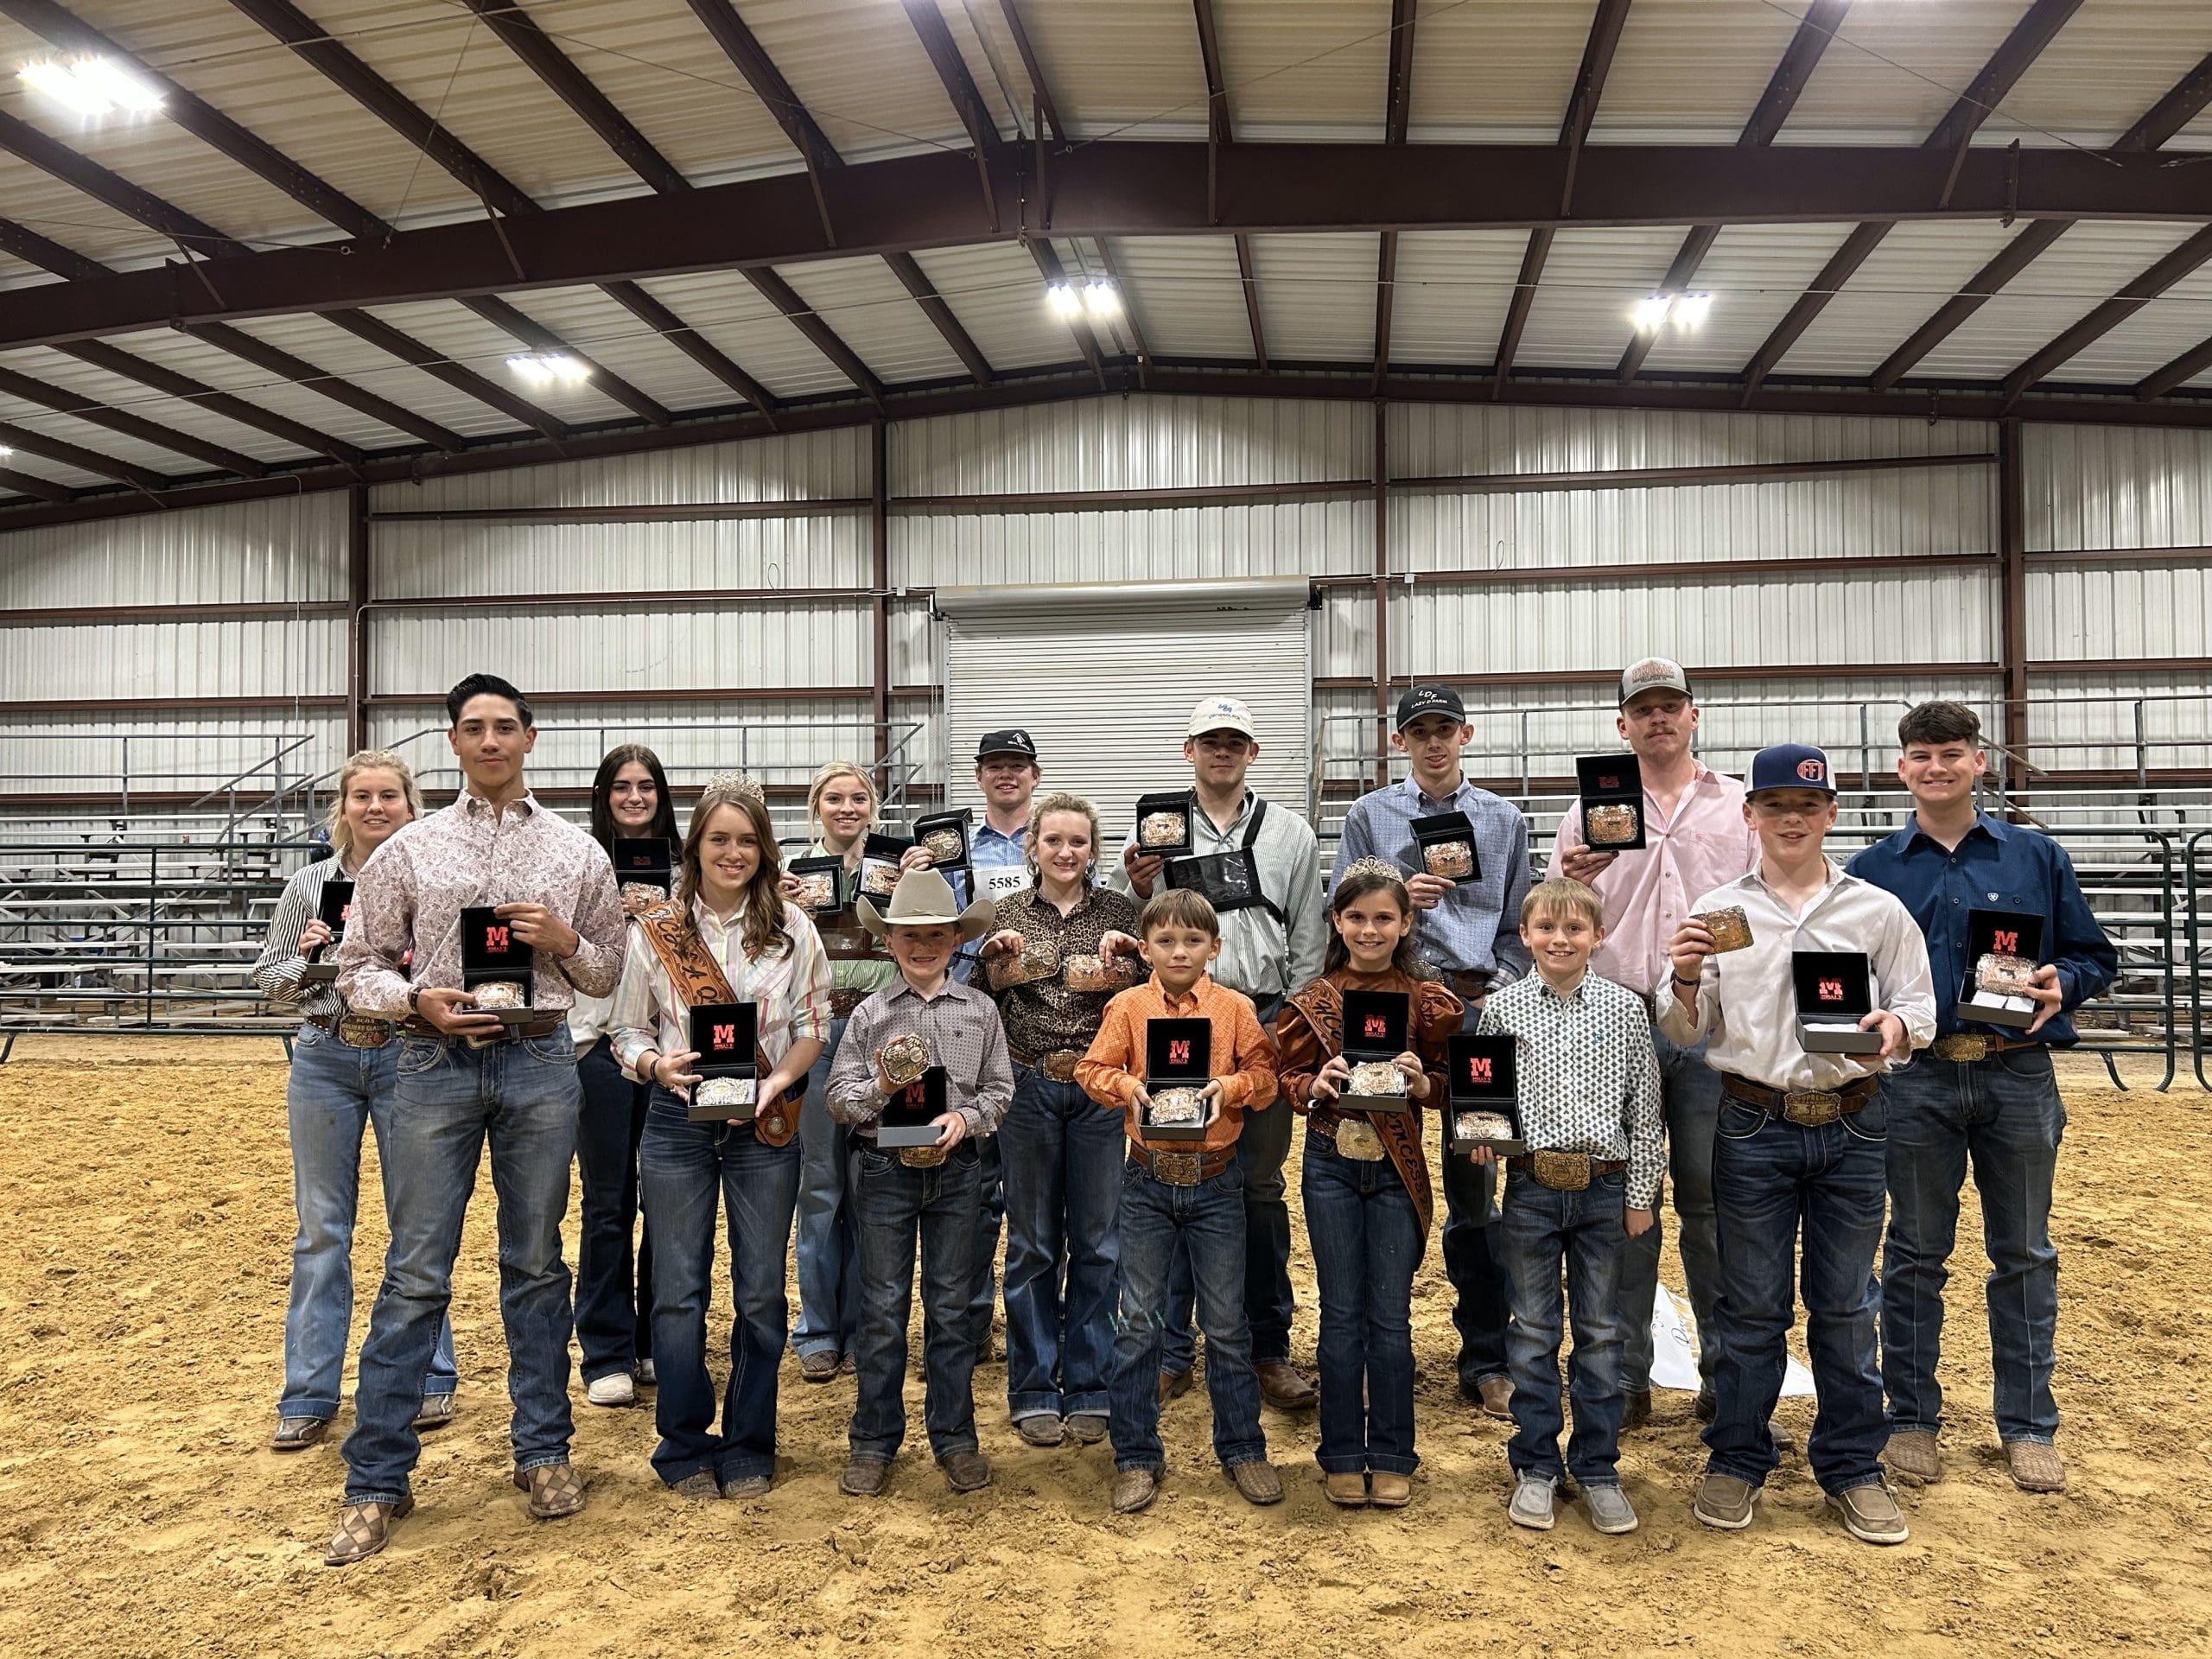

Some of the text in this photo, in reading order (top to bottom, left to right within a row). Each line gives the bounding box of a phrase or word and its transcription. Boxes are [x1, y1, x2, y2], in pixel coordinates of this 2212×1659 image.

[1631, 663, 1675, 681] PRIME
[1411, 699, 1426, 709] LAZY
[1418, 690, 1438, 700] LDF
[988, 875, 1020, 890] 5585
[486, 926, 509, 947] M
[1993, 930, 2018, 952] M
[1818, 977, 1843, 995] M
[1365, 1015, 1386, 1033] M
[713, 1024, 734, 1044] M
[1169, 1039, 1191, 1058] M
[1470, 1058, 1492, 1077] M
[905, 1083, 925, 1103] M
